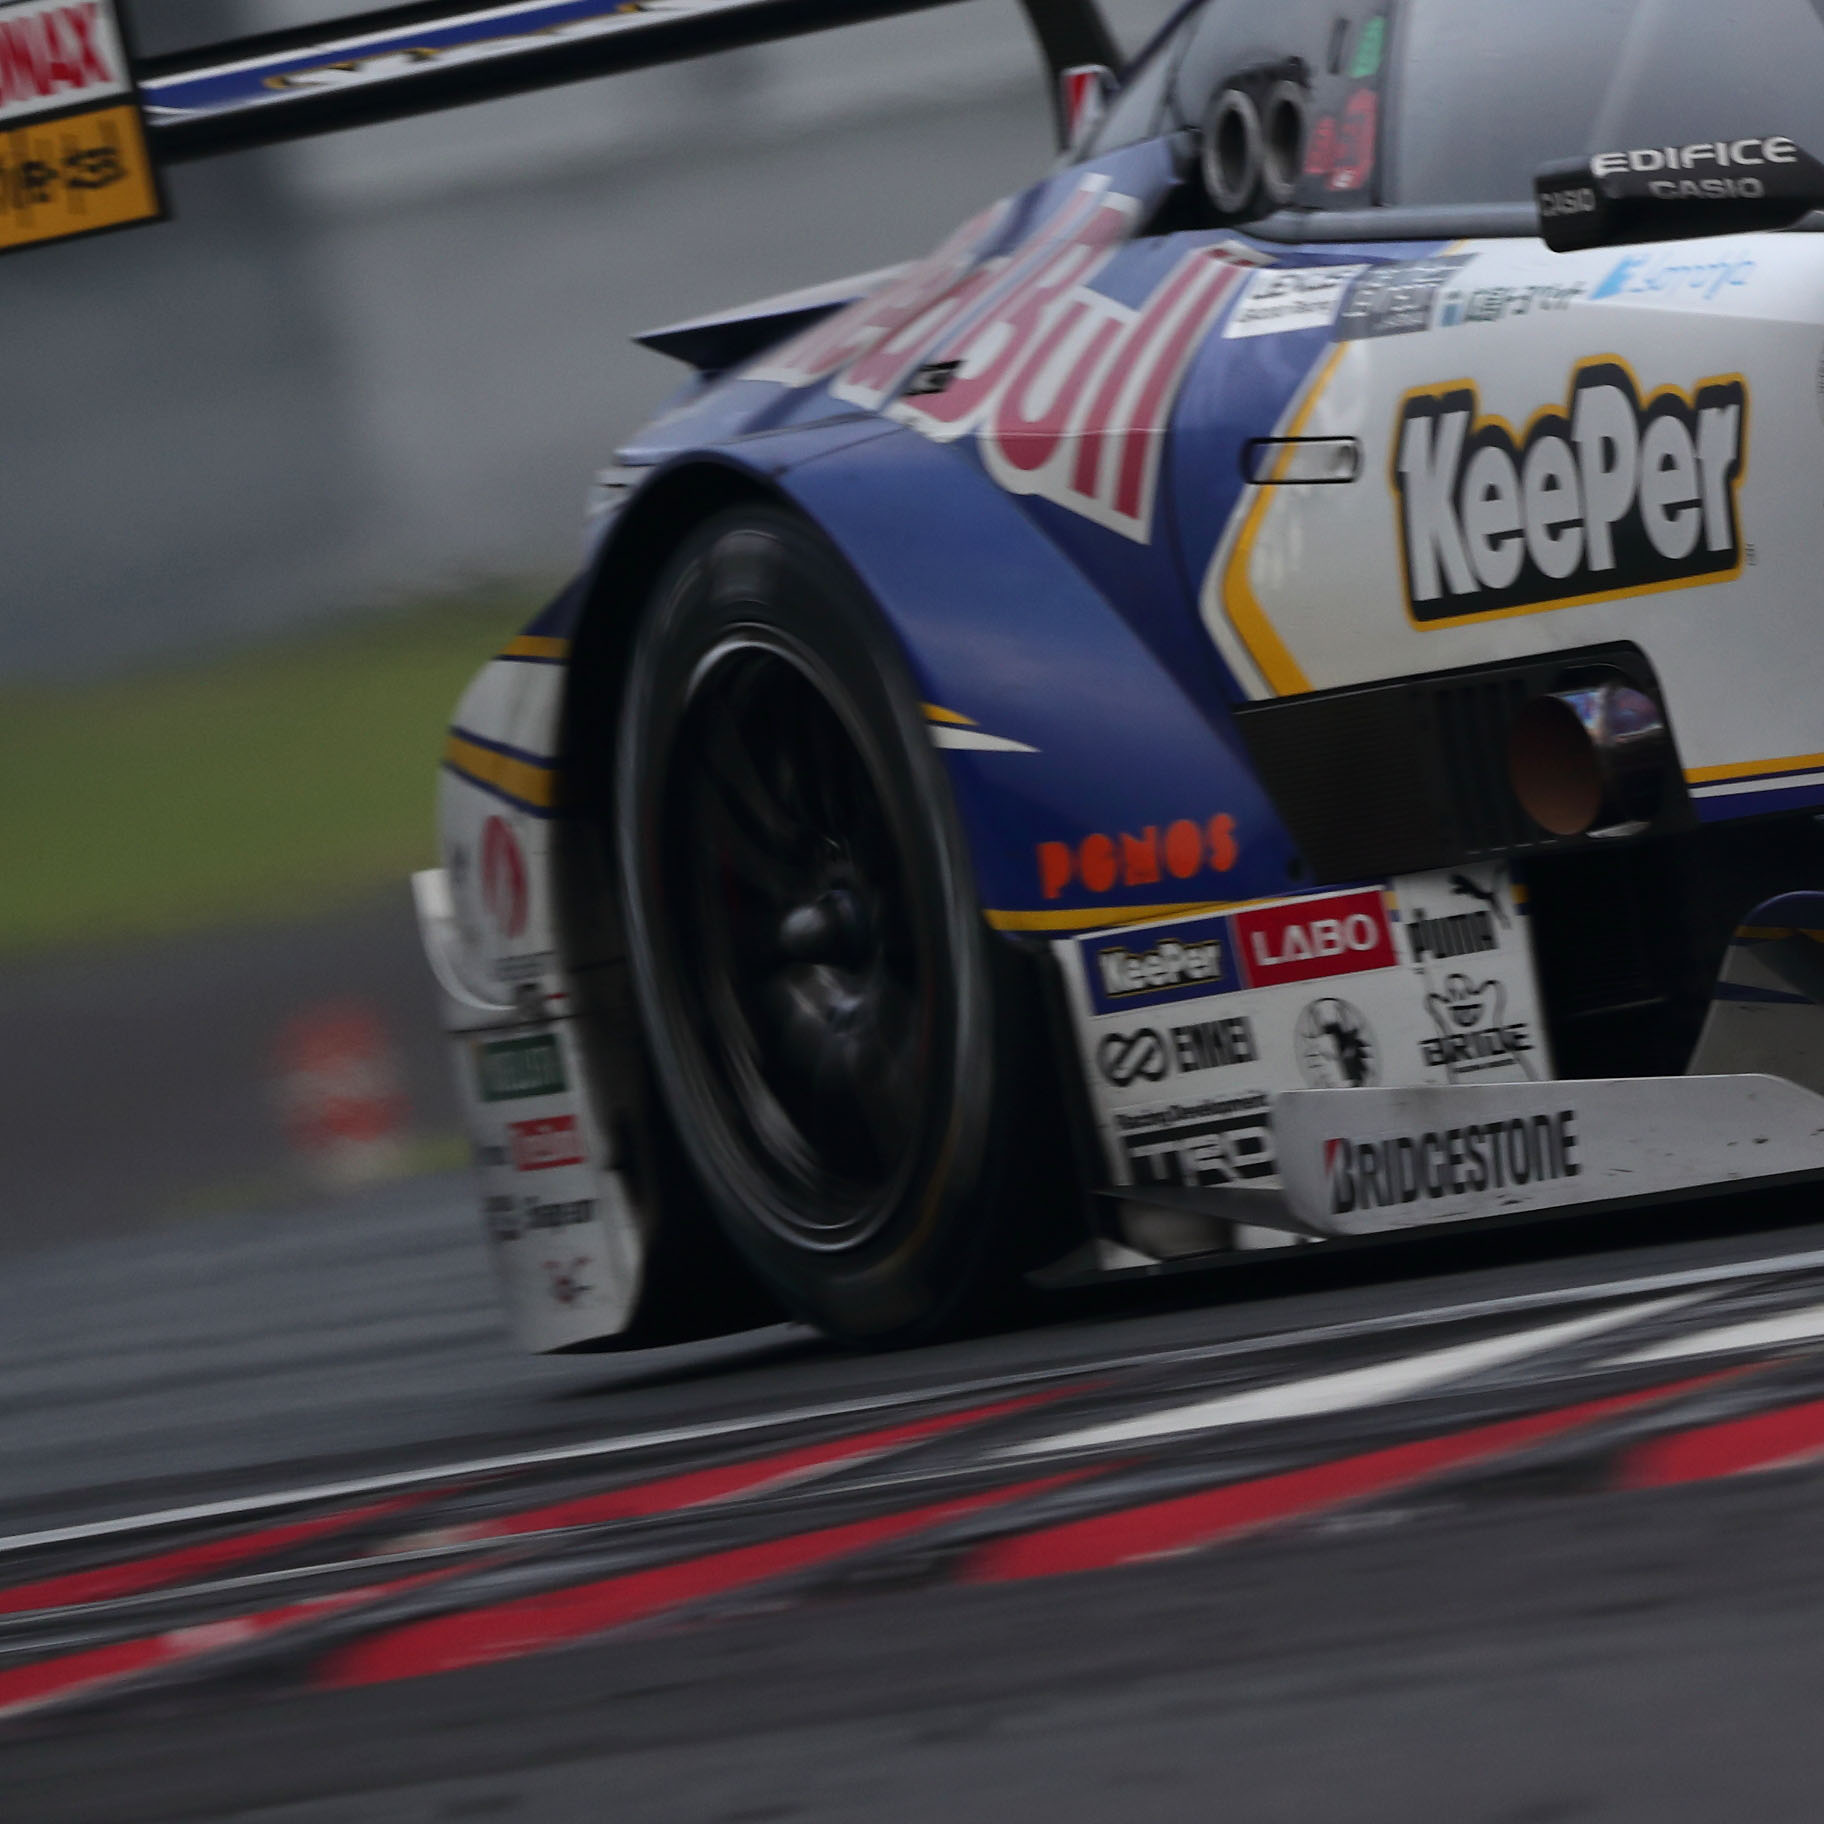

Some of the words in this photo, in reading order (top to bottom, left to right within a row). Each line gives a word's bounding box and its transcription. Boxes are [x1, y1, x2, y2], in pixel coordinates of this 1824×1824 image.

[1590, 136, 1798, 178] EDIFICE
[1649, 177, 1765, 200] CASIO
[1399, 382, 1742, 603] KeePer
[1037, 811, 1240, 900] PONOS
[1100, 937, 1224, 997] KeePer
[1251, 913, 1380, 967] LABO
[1322, 1108, 1581, 1215] BRIDGESTONE
